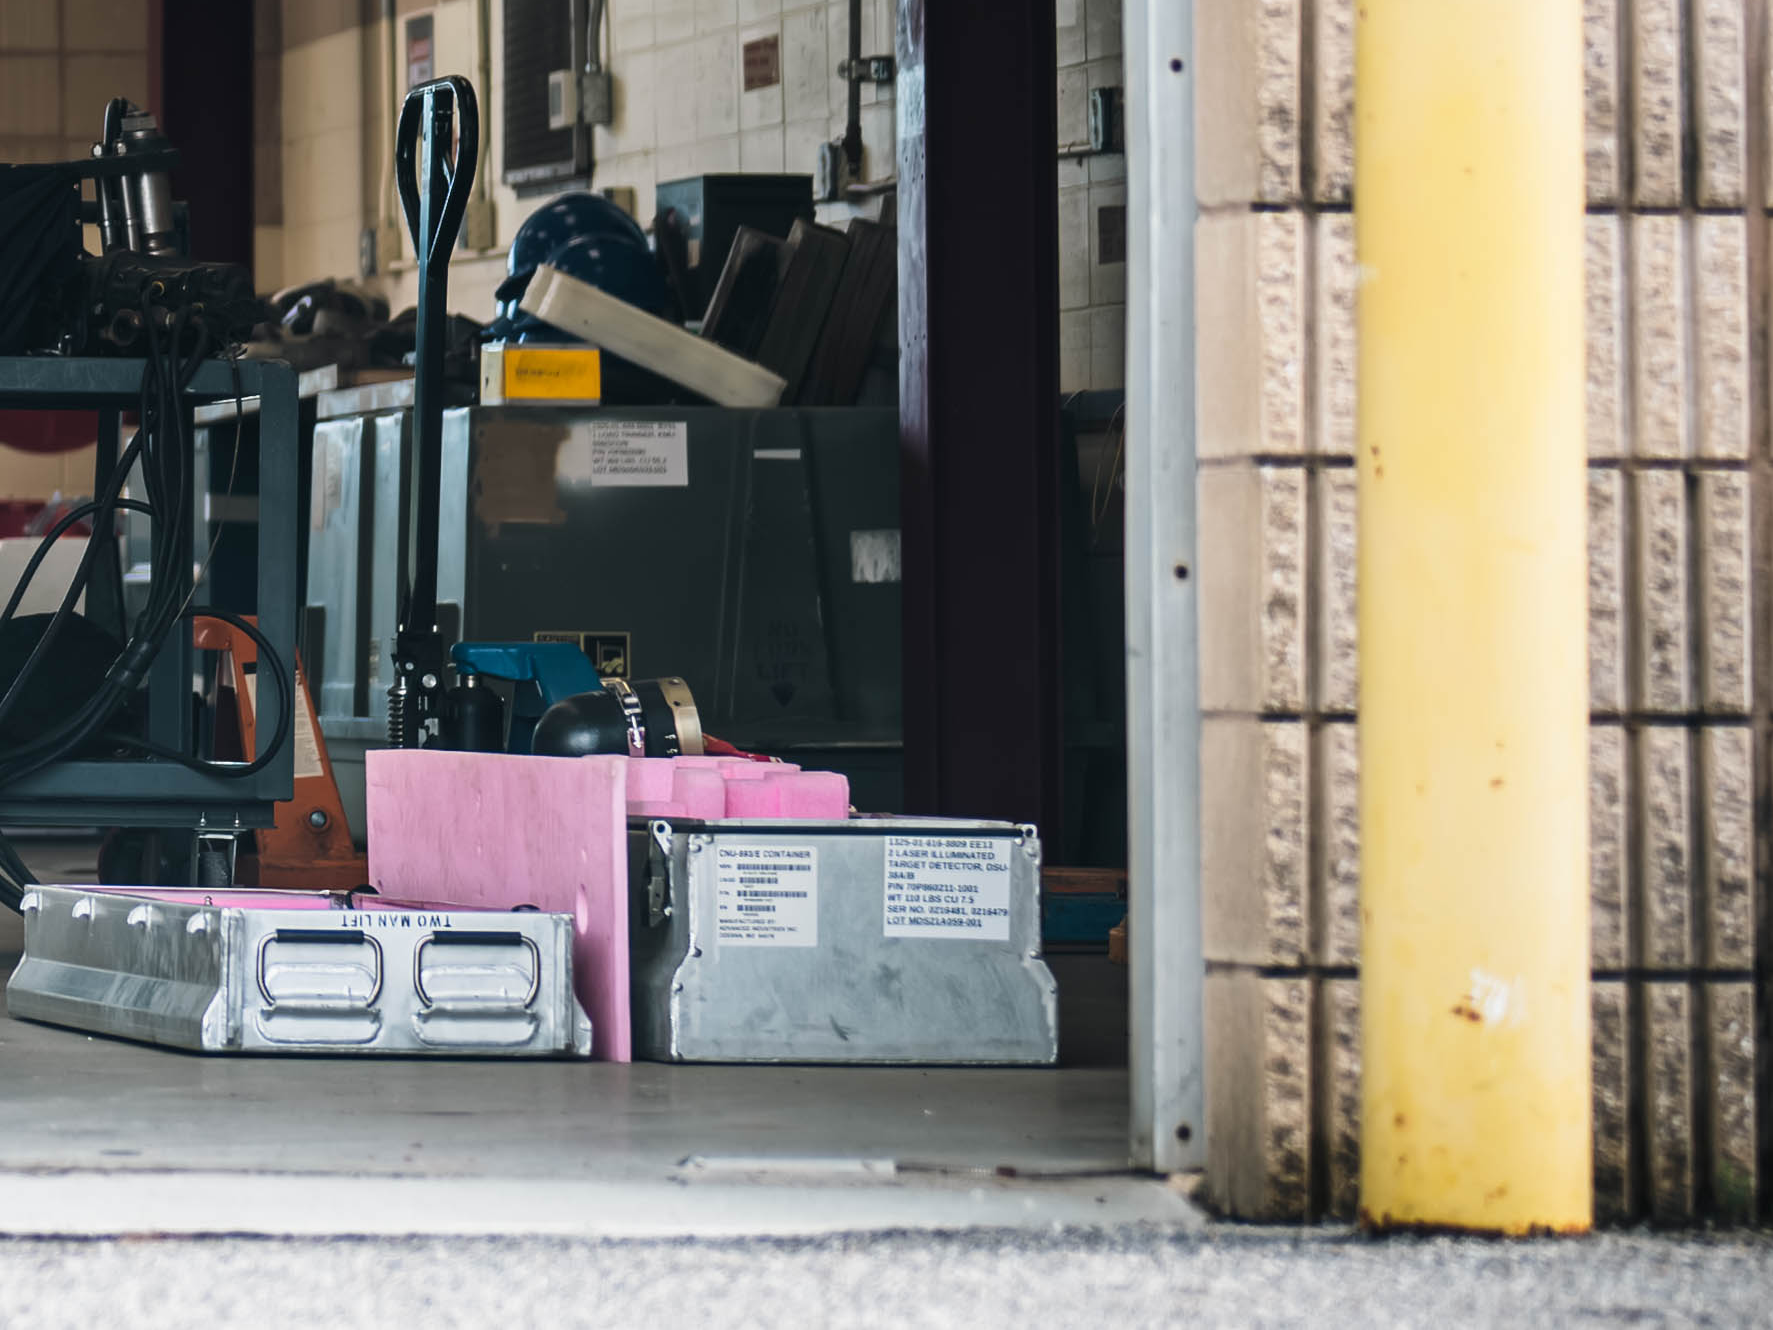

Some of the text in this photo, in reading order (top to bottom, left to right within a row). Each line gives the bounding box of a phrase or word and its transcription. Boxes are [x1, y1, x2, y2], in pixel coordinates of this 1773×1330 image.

[895, 849, 928, 858] LASER
[930, 850, 995, 860] ILLUMINATED
[888, 860, 926, 869] TARGET
[341, 914, 452, 928] TWO MAN LIFT
